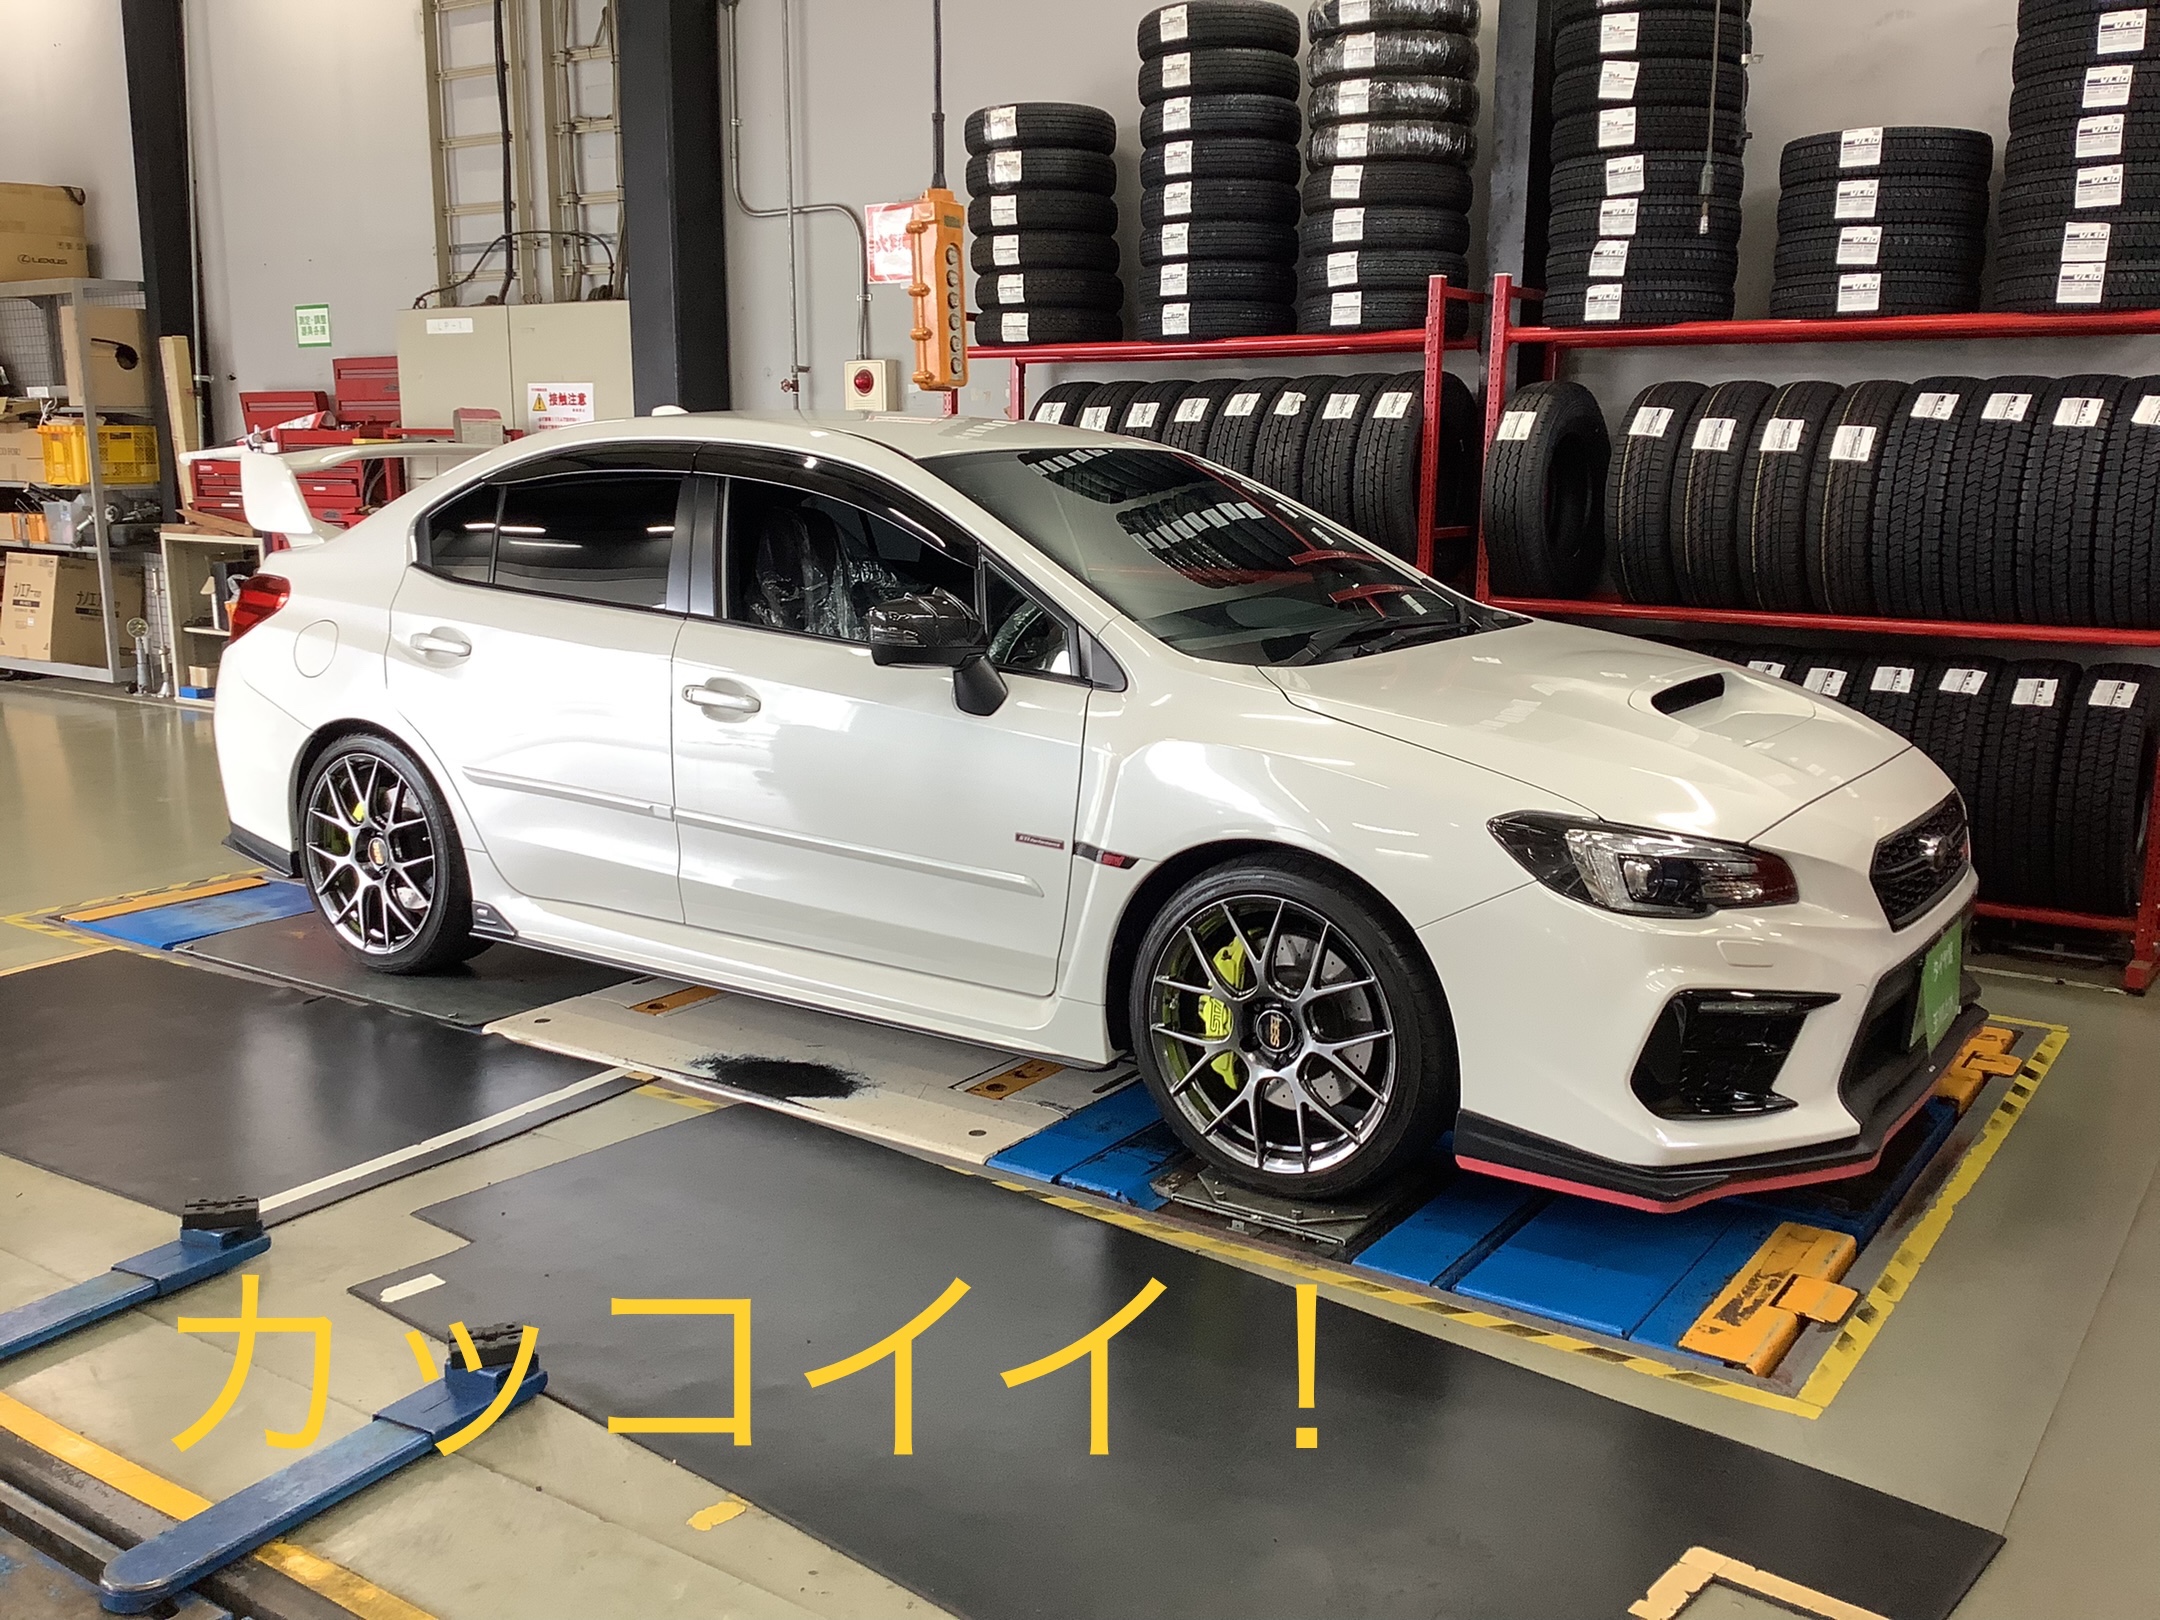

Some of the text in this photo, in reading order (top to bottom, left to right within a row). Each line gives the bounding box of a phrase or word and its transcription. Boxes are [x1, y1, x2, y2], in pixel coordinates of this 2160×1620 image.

[31, 256, 68, 265] LEXUS
[549, 392, 587, 406] 接触注意
